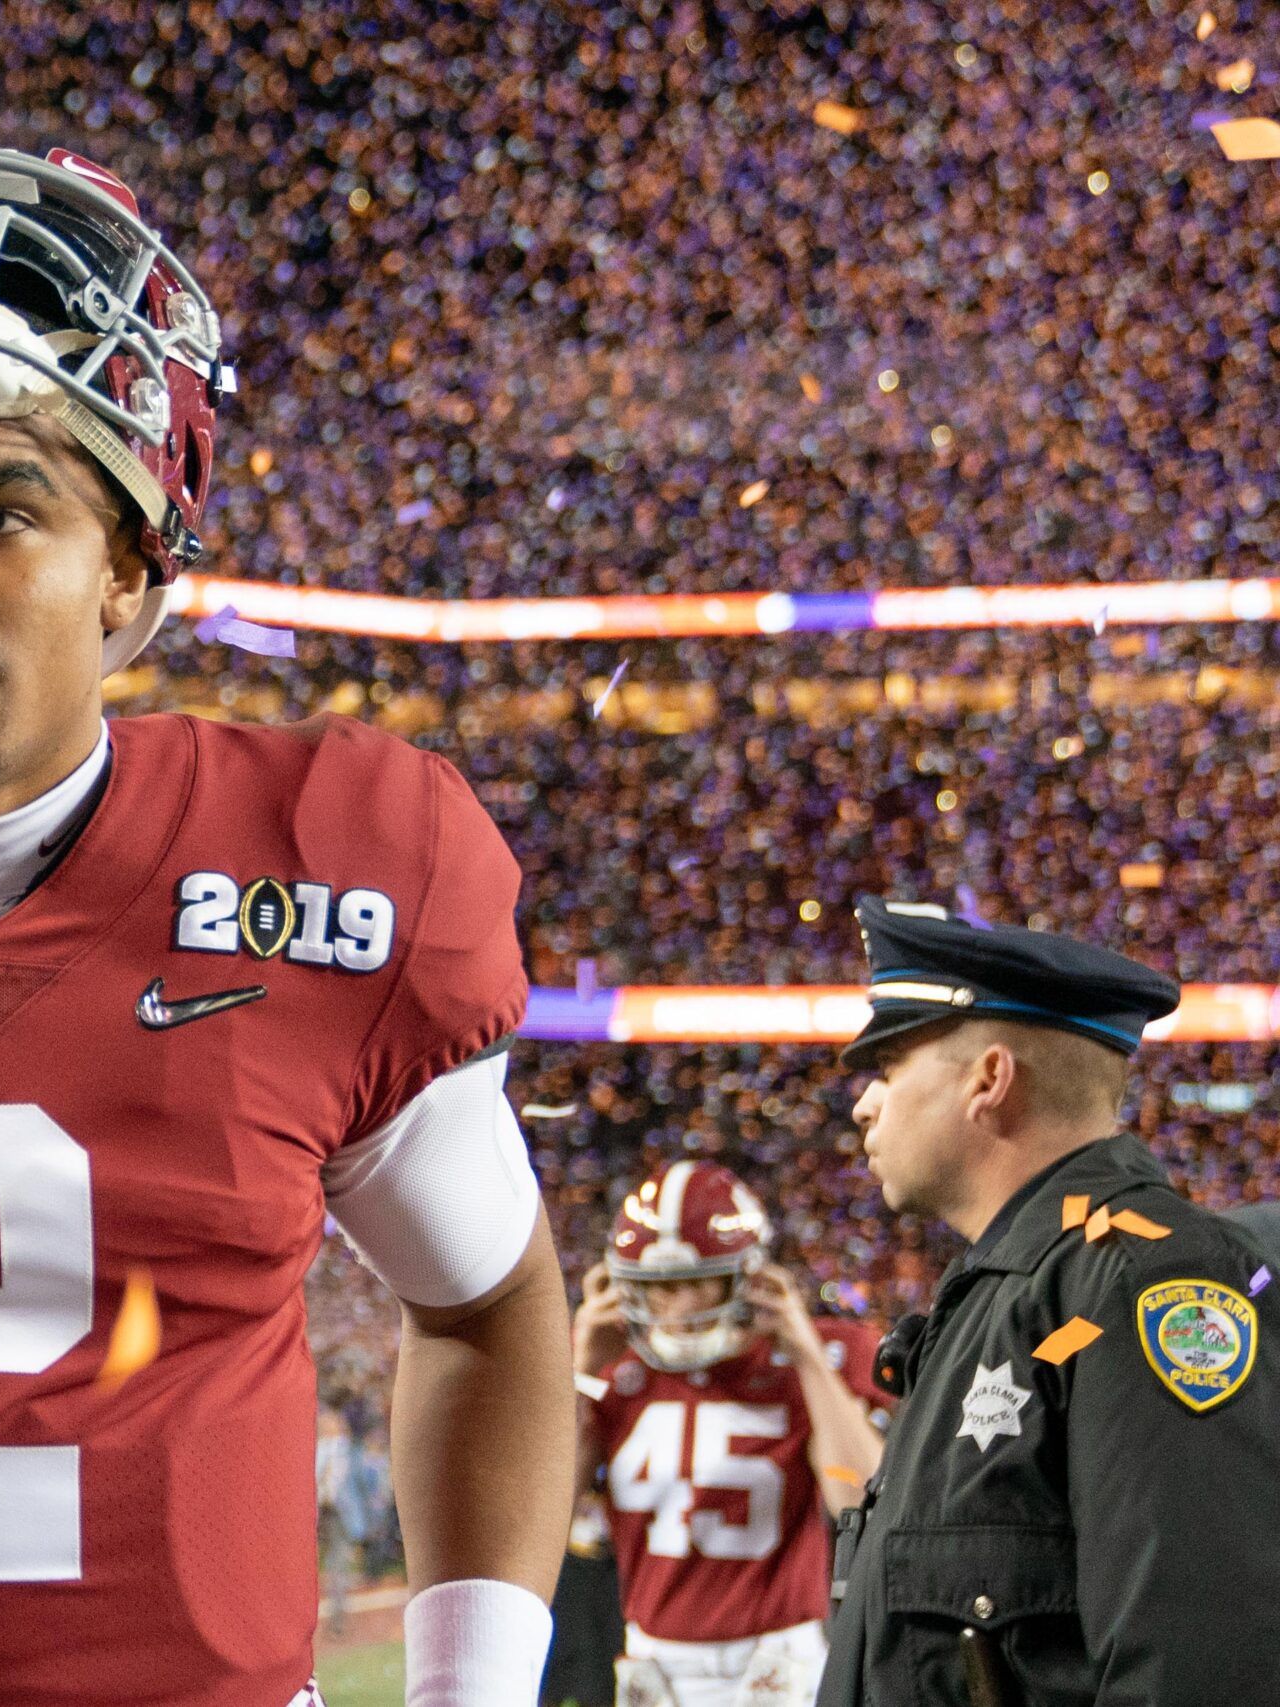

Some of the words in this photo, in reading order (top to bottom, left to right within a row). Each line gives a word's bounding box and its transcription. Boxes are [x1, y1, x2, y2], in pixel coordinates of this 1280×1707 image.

[177, 871, 395, 972] 2019
[1144, 1287, 1197, 1312] SANTA
[1203, 1287, 1250, 1327] CLARA
[1170, 1368, 1231, 1389] POLICE
[609, 1400, 788, 1560] 45
